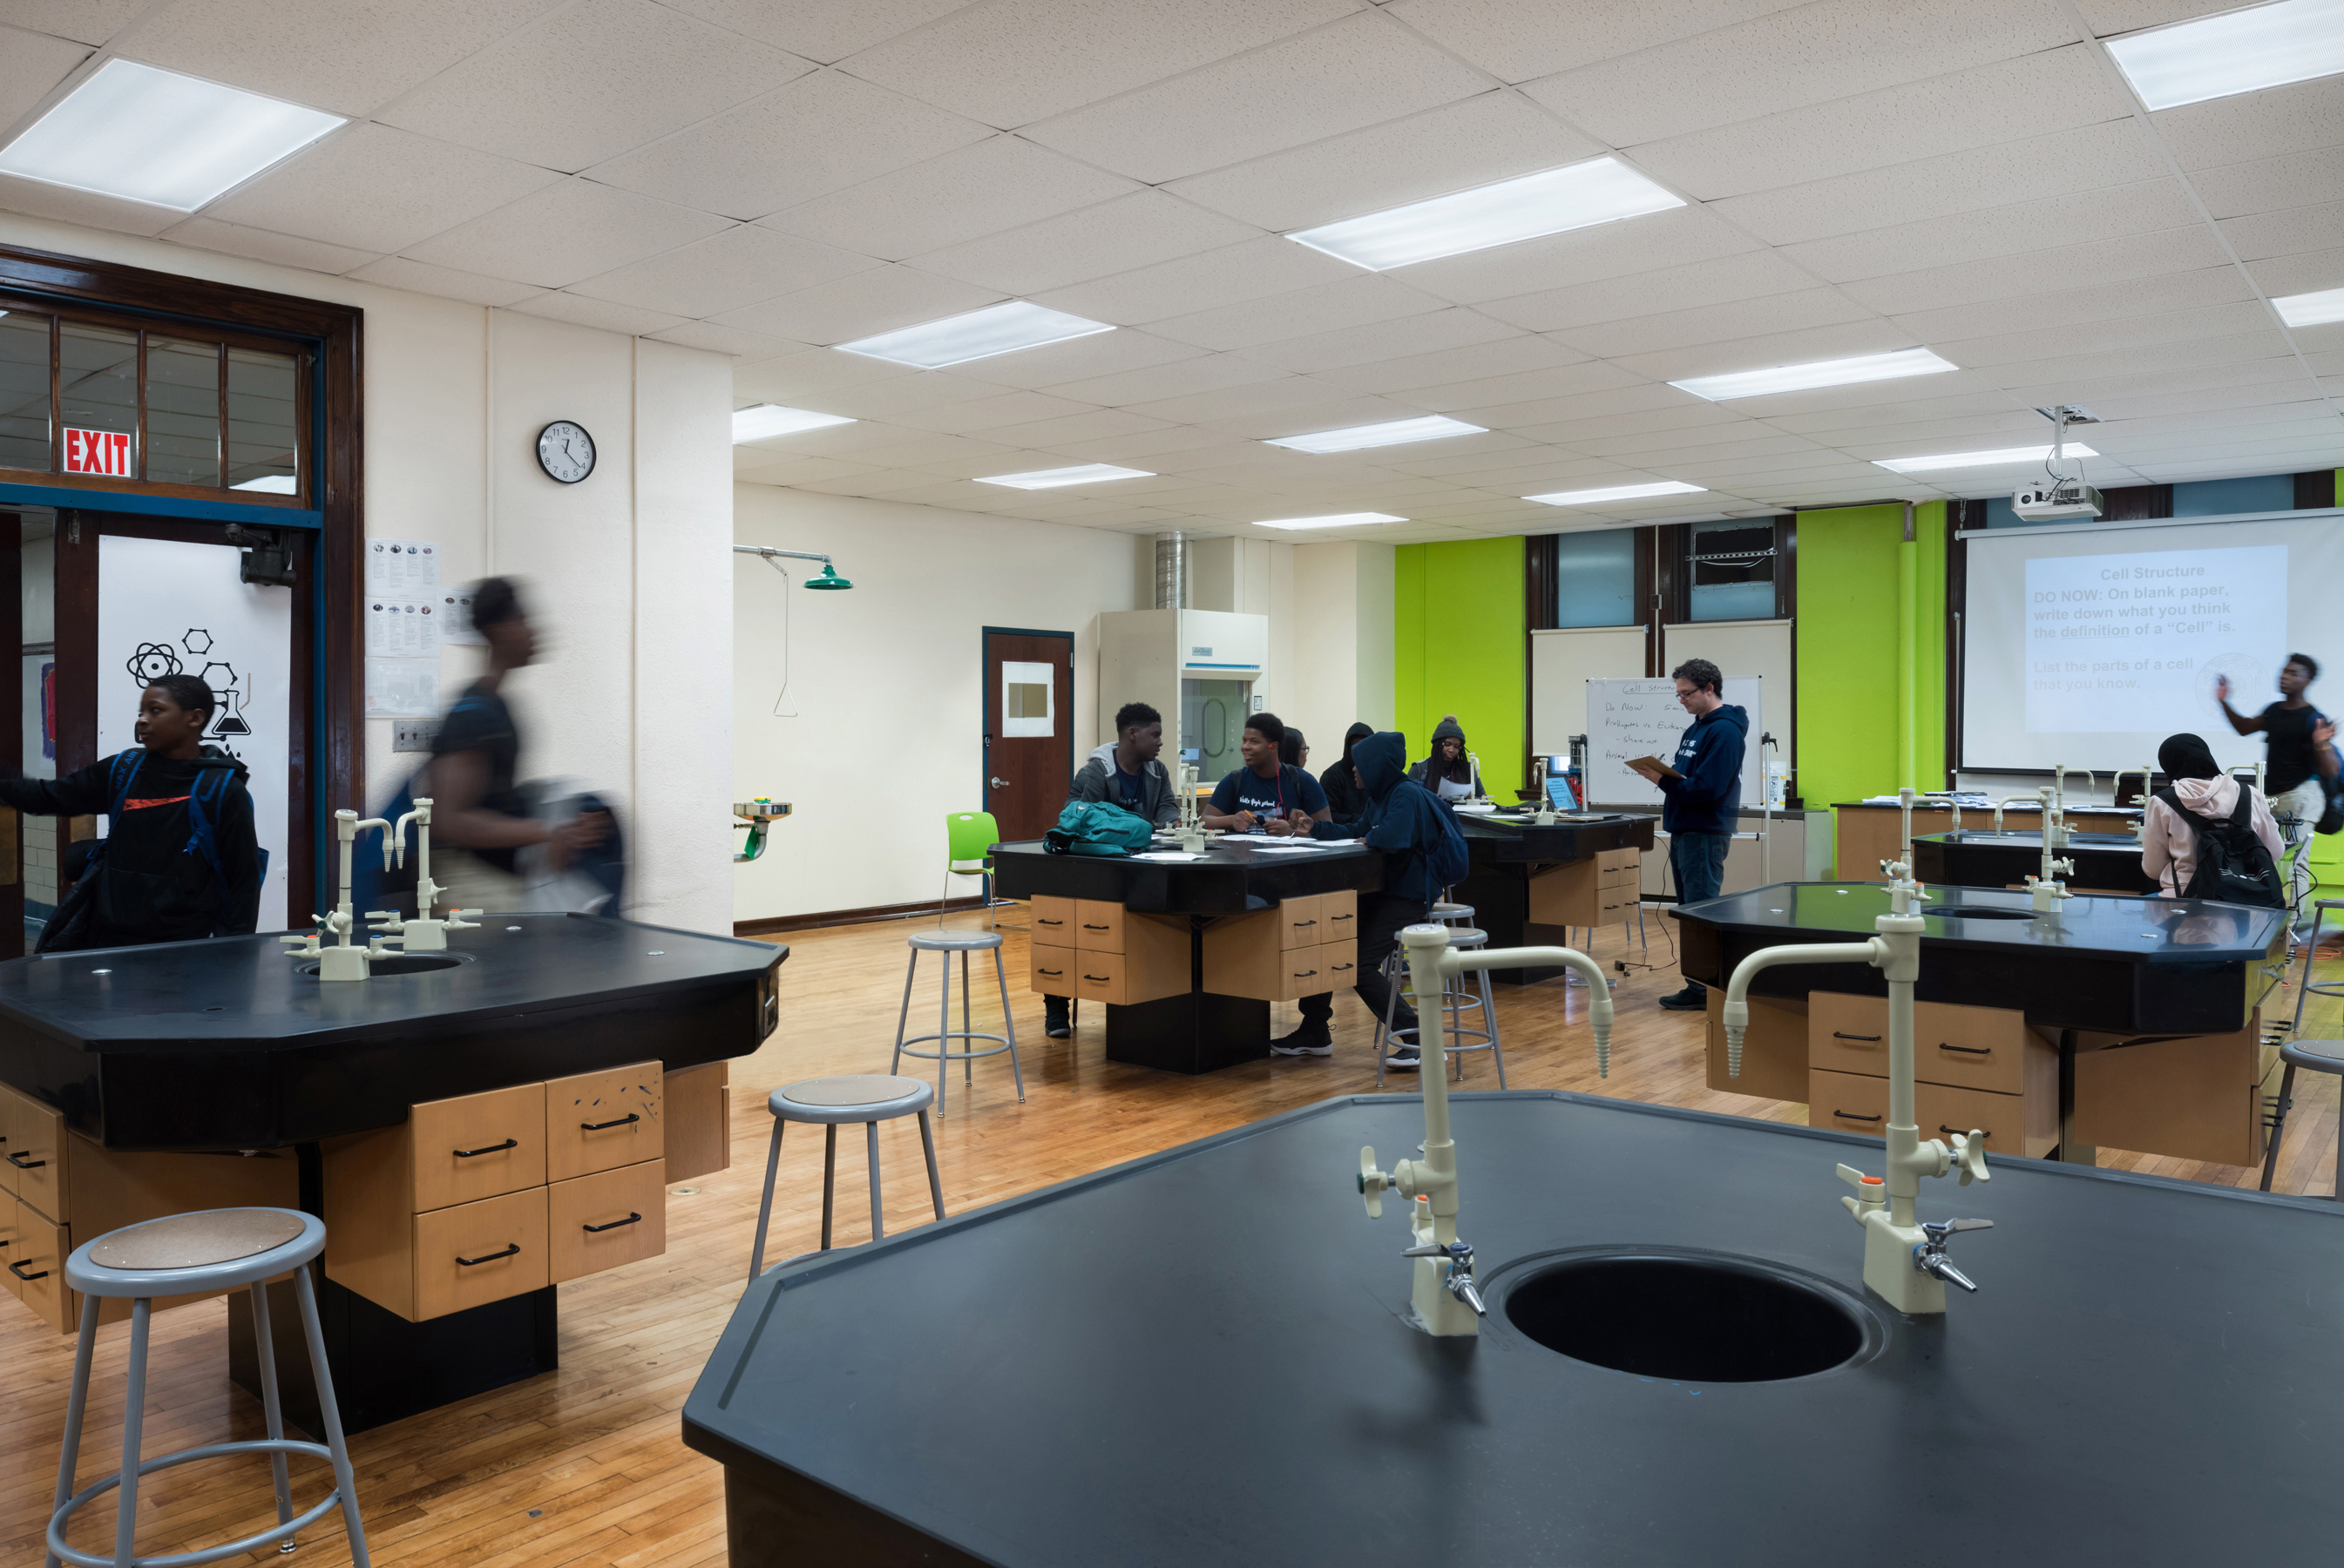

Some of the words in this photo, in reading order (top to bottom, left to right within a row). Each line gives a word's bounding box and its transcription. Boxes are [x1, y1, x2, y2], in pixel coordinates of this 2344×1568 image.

[562, 426, 570, 435] 12
[67, 429, 128, 475] EXIT
[2101, 568, 2129, 581] Cell
[2134, 566, 2205, 579] Structure
[2034, 591, 2056, 603] DO
[2061, 589, 2103, 602] NOW:
[2108, 588, 2129, 600] On
[2134, 586, 2176, 599] blank
[2180, 585, 2229, 599] paper,
[2034, 609, 2069, 621] write
[2073, 608, 2114, 620] down
[2118, 605, 2154, 618] what
[2158, 606, 2186, 619] you
[2192, 602, 2231, 615] think
[2034, 626, 2056, 639] the
[2061, 623, 2130, 638] definition
[2134, 623, 2149, 635] of
[2154, 625, 2162, 634] a
[2168, 621, 2212, 634] “Cell”
[2218, 620, 2236, 632] is.
[2034, 661, 2060, 673] List
[2065, 660, 2087, 672] the
[2092, 659, 2129, 674] parts
[2134, 658, 2150, 671] of
[2154, 661, 2162, 670] a
[2167, 658, 2193, 669] cell
[1623, 683, 1641, 693] Cell
[2034, 679, 2061, 690] that
[2066, 679, 2092, 692] you
[2097, 677, 2140, 689] know.
[1606, 702, 1615, 711] Do
[1606, 750, 1628, 760] Animal
[115, 767, 127, 791] MAX
[124, 751, 139, 764] AIR
